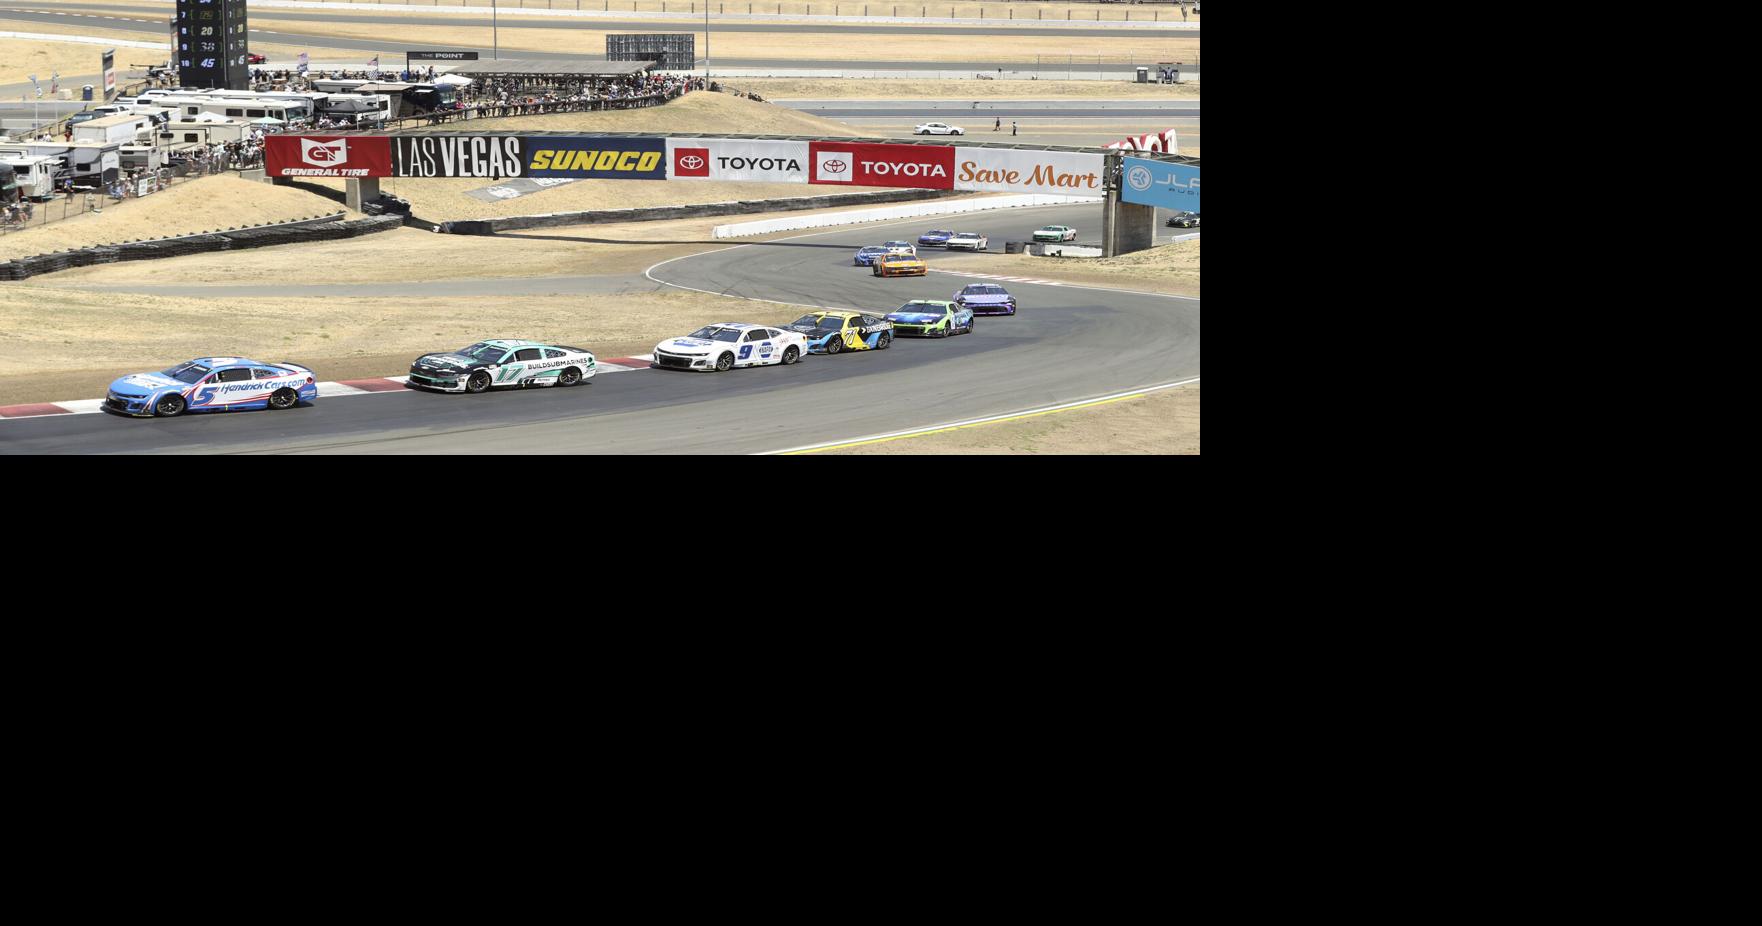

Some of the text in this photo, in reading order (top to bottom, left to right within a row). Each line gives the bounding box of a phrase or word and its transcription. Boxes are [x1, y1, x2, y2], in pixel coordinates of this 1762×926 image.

[201, 27, 213, 35] 20
[200, 42, 215, 52] 38
[200, 58, 216, 68] 45
[307, 146, 342, 161] GT
[397, 136, 522, 177] LAS VEGAS
[529, 149, 661, 172] SUNOCO
[717, 156, 801, 171] TOYOTA
[860, 161, 947, 177] TOYOTA
[281, 168, 370, 176] GENERAL TIRE
[958, 161, 1099, 189] Save Mart
[737, 344, 753, 360] 9
[527, 357, 588, 370] BUILDSUBMARINES
[494, 363, 527, 384] 17
[191, 386, 220, 406] 5
